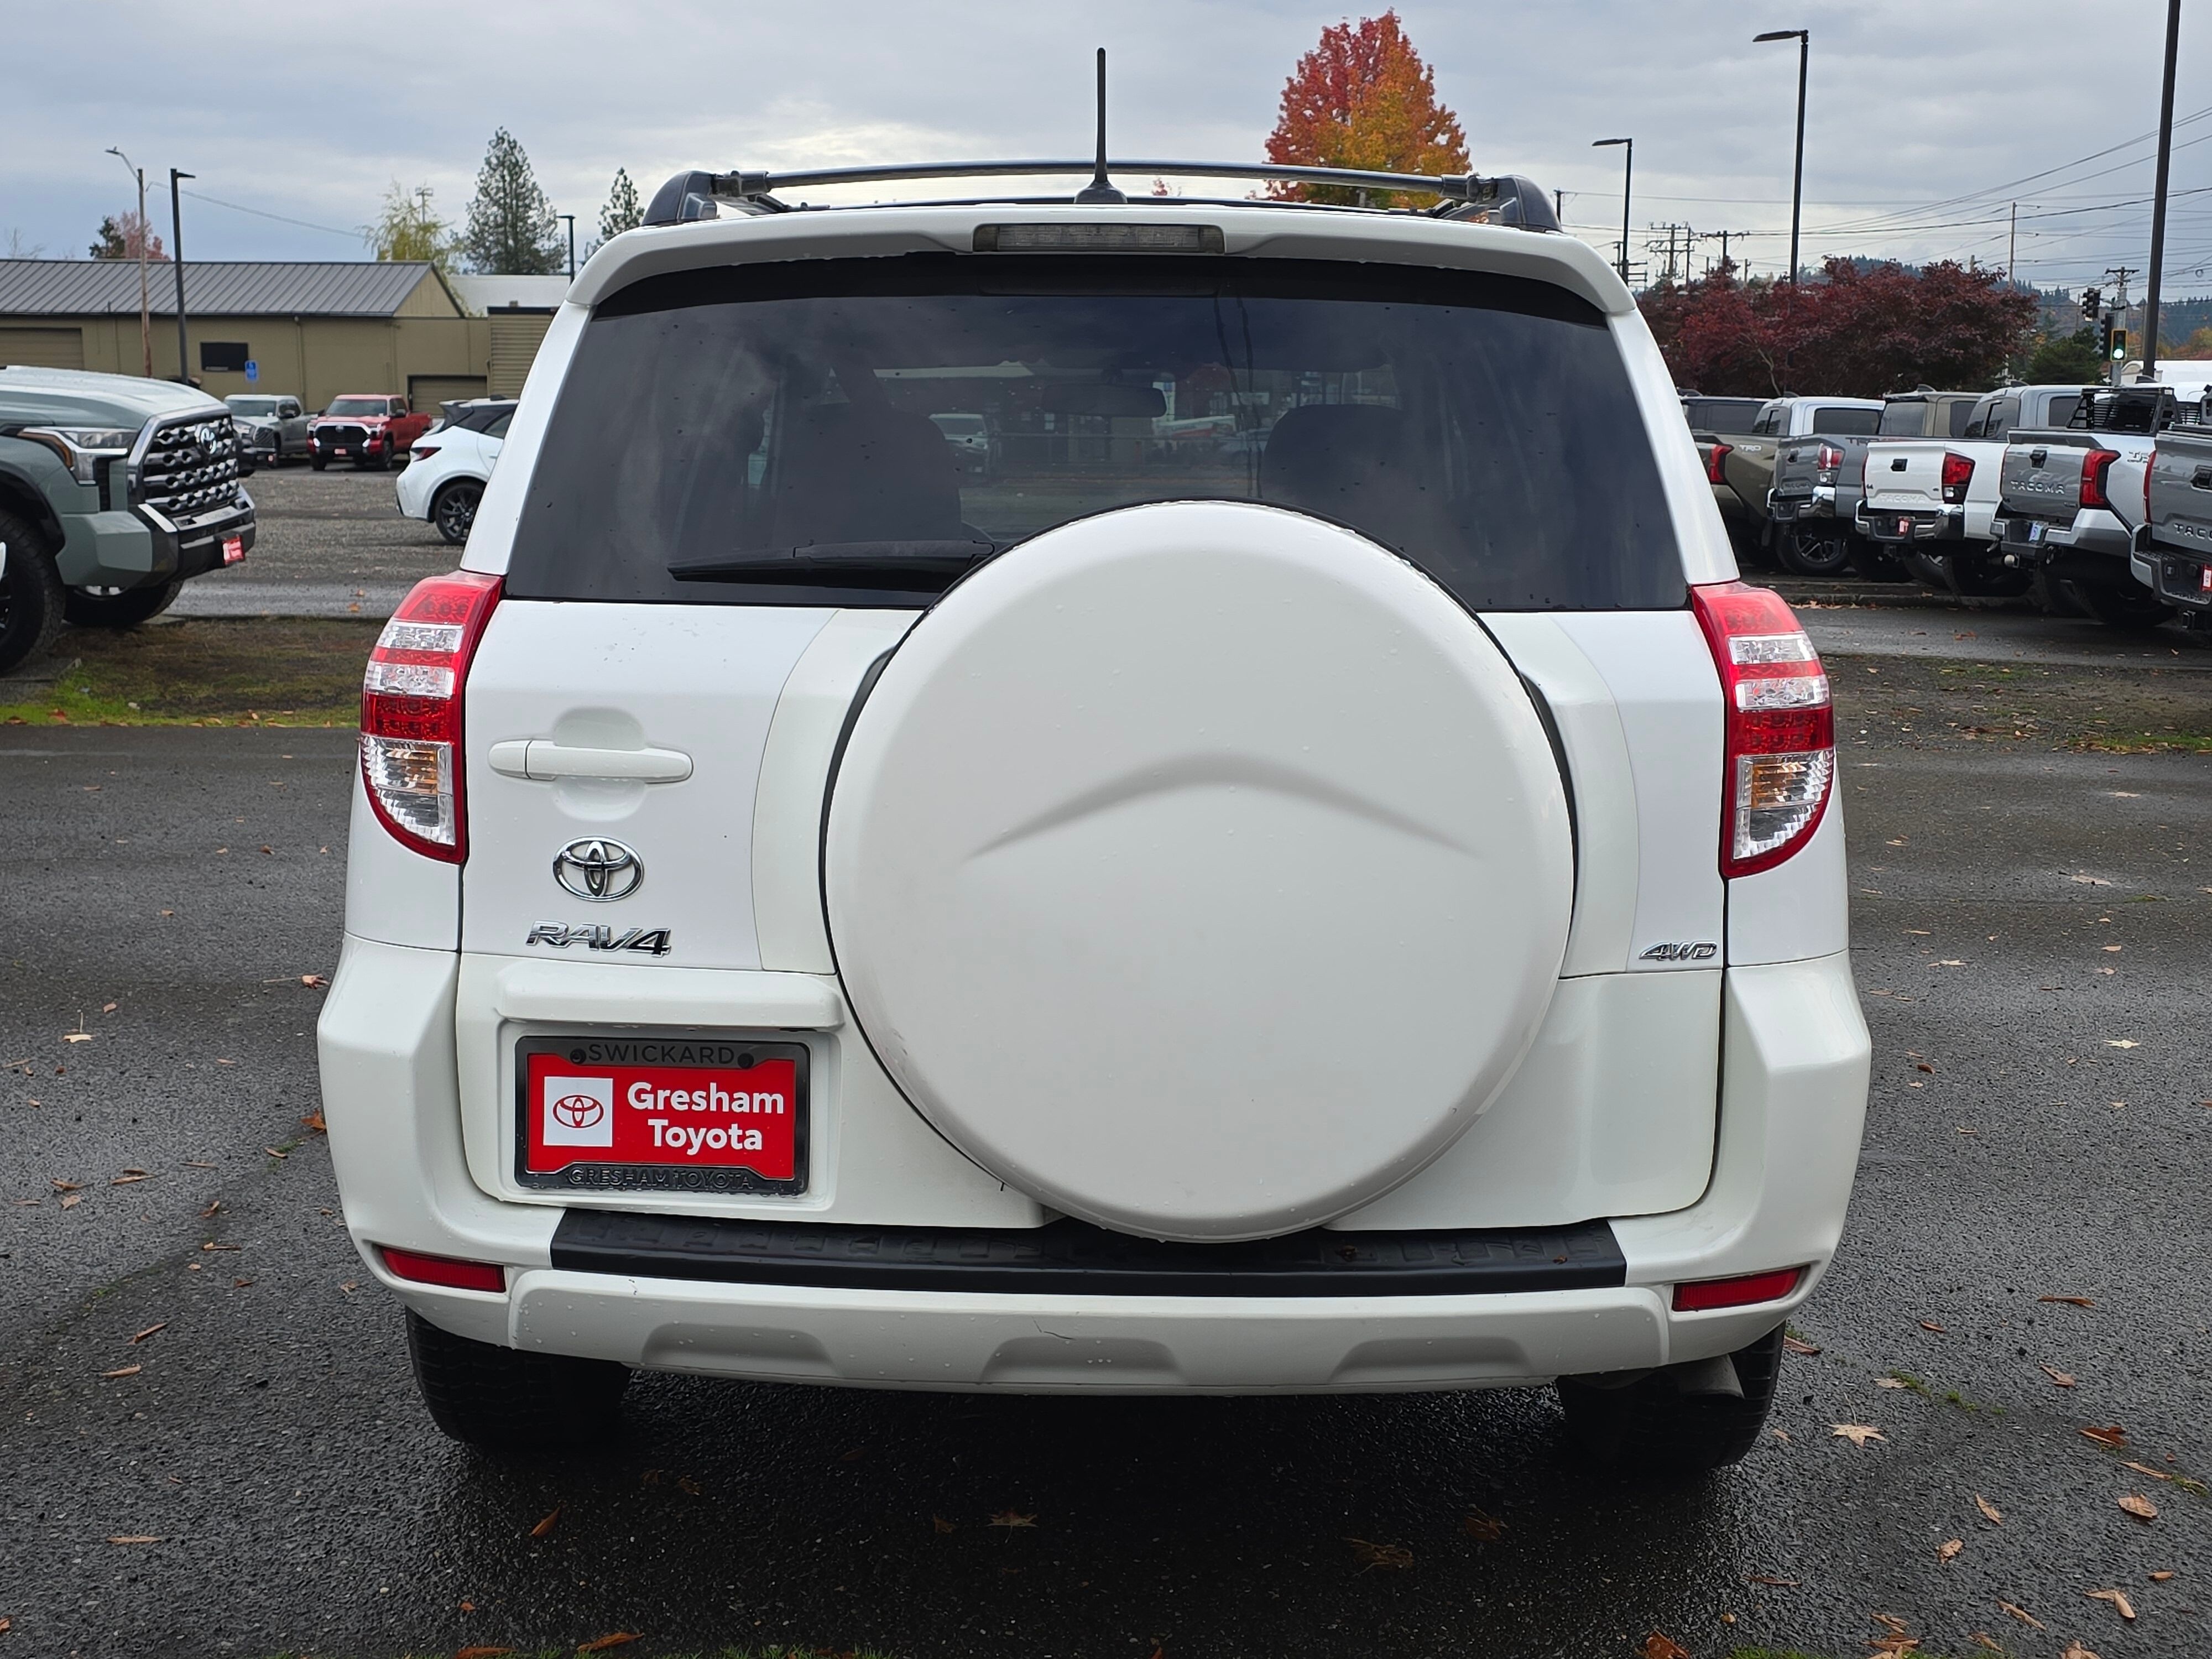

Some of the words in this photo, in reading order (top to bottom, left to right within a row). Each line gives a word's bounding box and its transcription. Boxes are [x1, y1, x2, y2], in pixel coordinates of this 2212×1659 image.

[2010, 479, 2065, 494] TACOMA
[525, 919, 671, 958] RAV4
[1638, 940, 1718, 961] 4WD
[588, 1043, 735, 1065] SWICKARD
[627, 1081, 784, 1114] Gresham
[648, 1119, 763, 1155] Toyota
[568, 1166, 670, 1187] GRESHAM
[674, 1169, 754, 1190] TOYOTA
